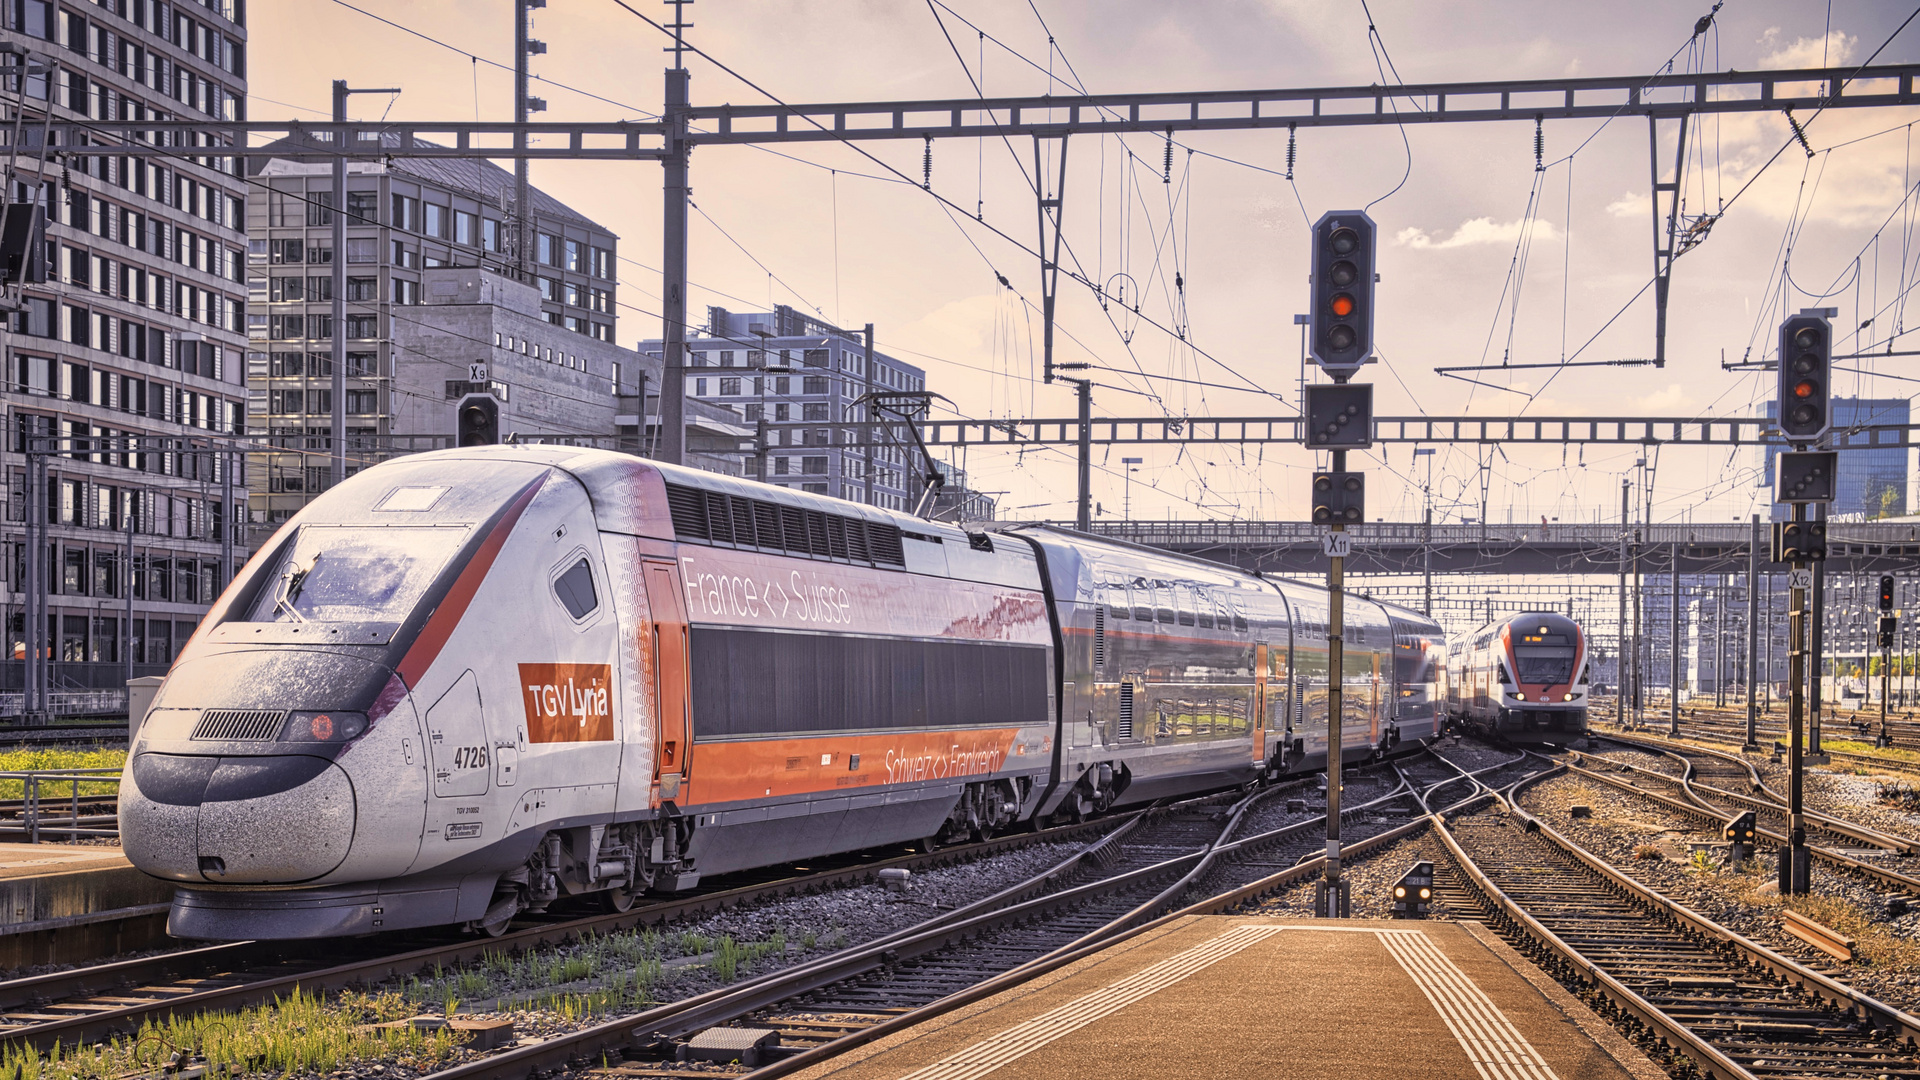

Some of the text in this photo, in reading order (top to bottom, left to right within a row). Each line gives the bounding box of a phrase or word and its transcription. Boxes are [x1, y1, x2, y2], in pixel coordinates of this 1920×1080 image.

[1329, 534, 1347, 553] X11
[681, 556, 759, 618] France
[790, 569, 851, 625] Suisse
[1791, 571, 1809, 586] X12
[528, 677, 608, 728] TGV Lyria
[454, 746, 486, 769] 4726
[883, 746, 932, 785] Schweiz
[949, 741, 1000, 777] Frankreich
